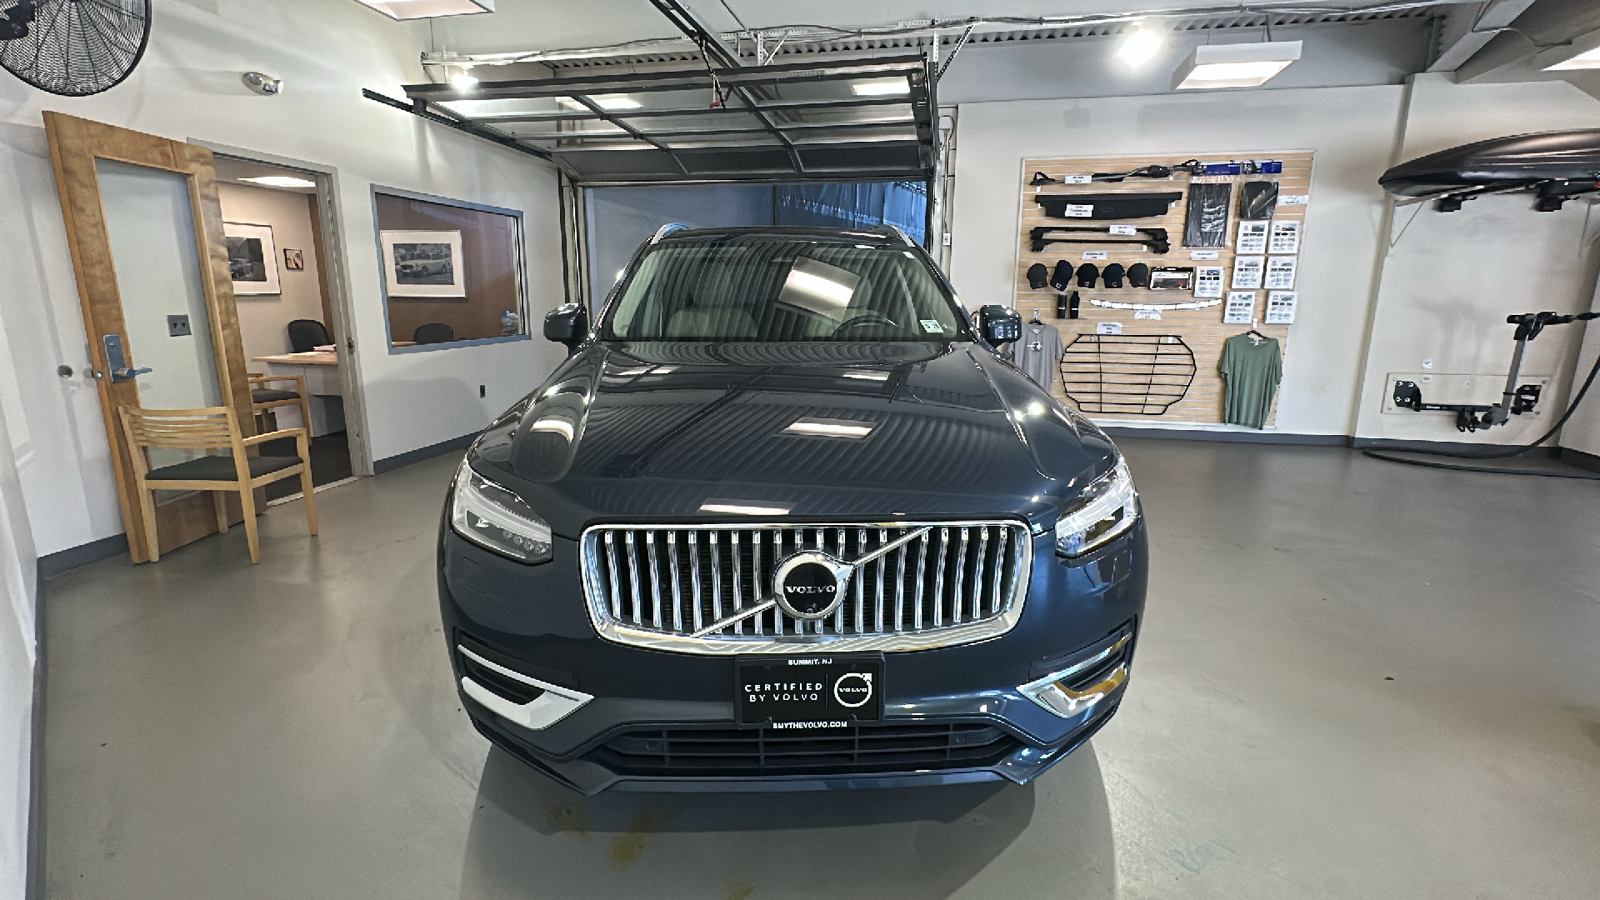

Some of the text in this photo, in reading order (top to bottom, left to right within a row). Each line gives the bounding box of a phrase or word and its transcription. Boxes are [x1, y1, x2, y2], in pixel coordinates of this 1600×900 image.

[785, 585, 836, 594] VOLVO
[787, 658, 820, 666] SUMMIT,
[744, 682, 823, 692] CERTIFIED
[749, 693, 818, 703] BY VOLVO
